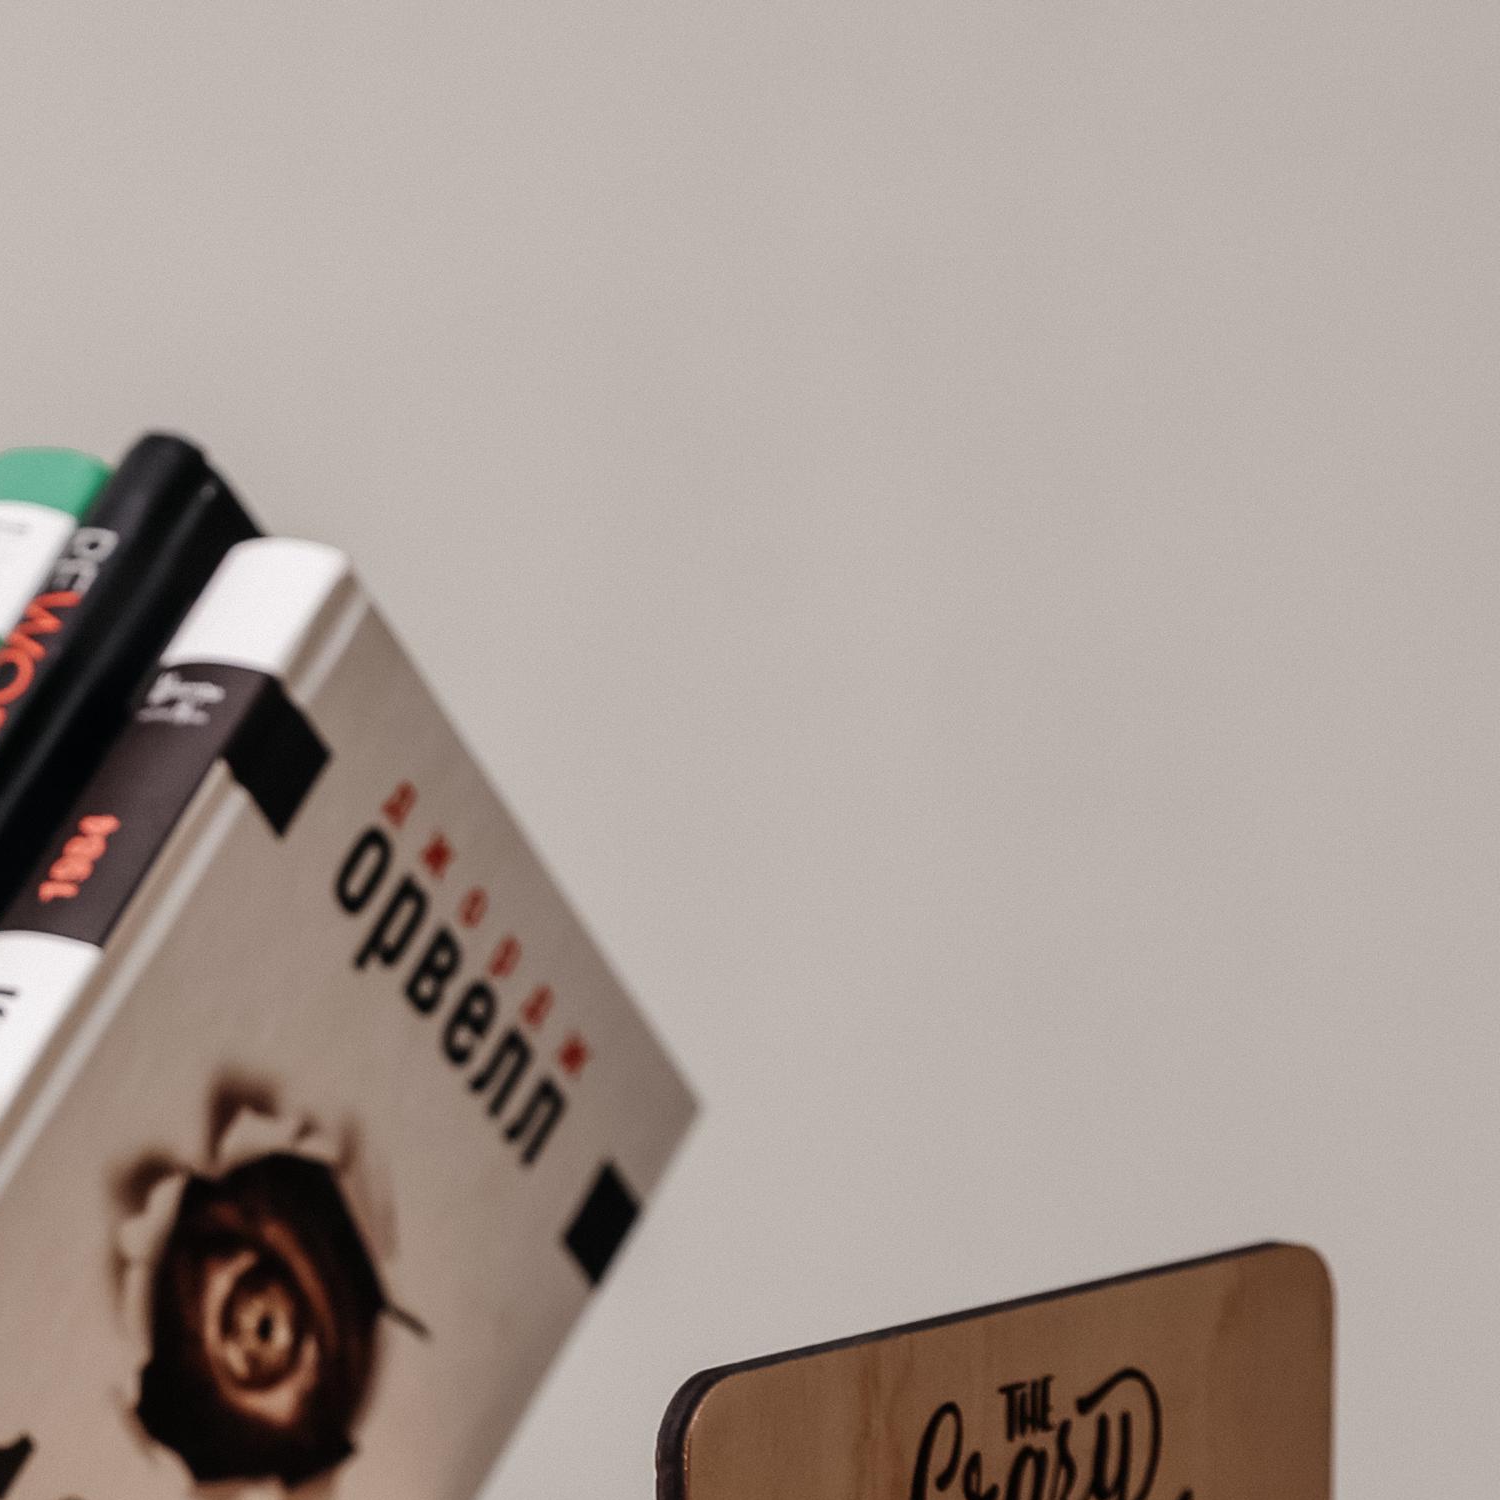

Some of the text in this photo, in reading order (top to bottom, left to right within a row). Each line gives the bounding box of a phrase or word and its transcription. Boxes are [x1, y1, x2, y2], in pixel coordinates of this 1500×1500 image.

[37, 812, 120, 903] 1984
[333, 825, 570, 1168] орвелл
[999, 1375, 1056, 1442] THE
